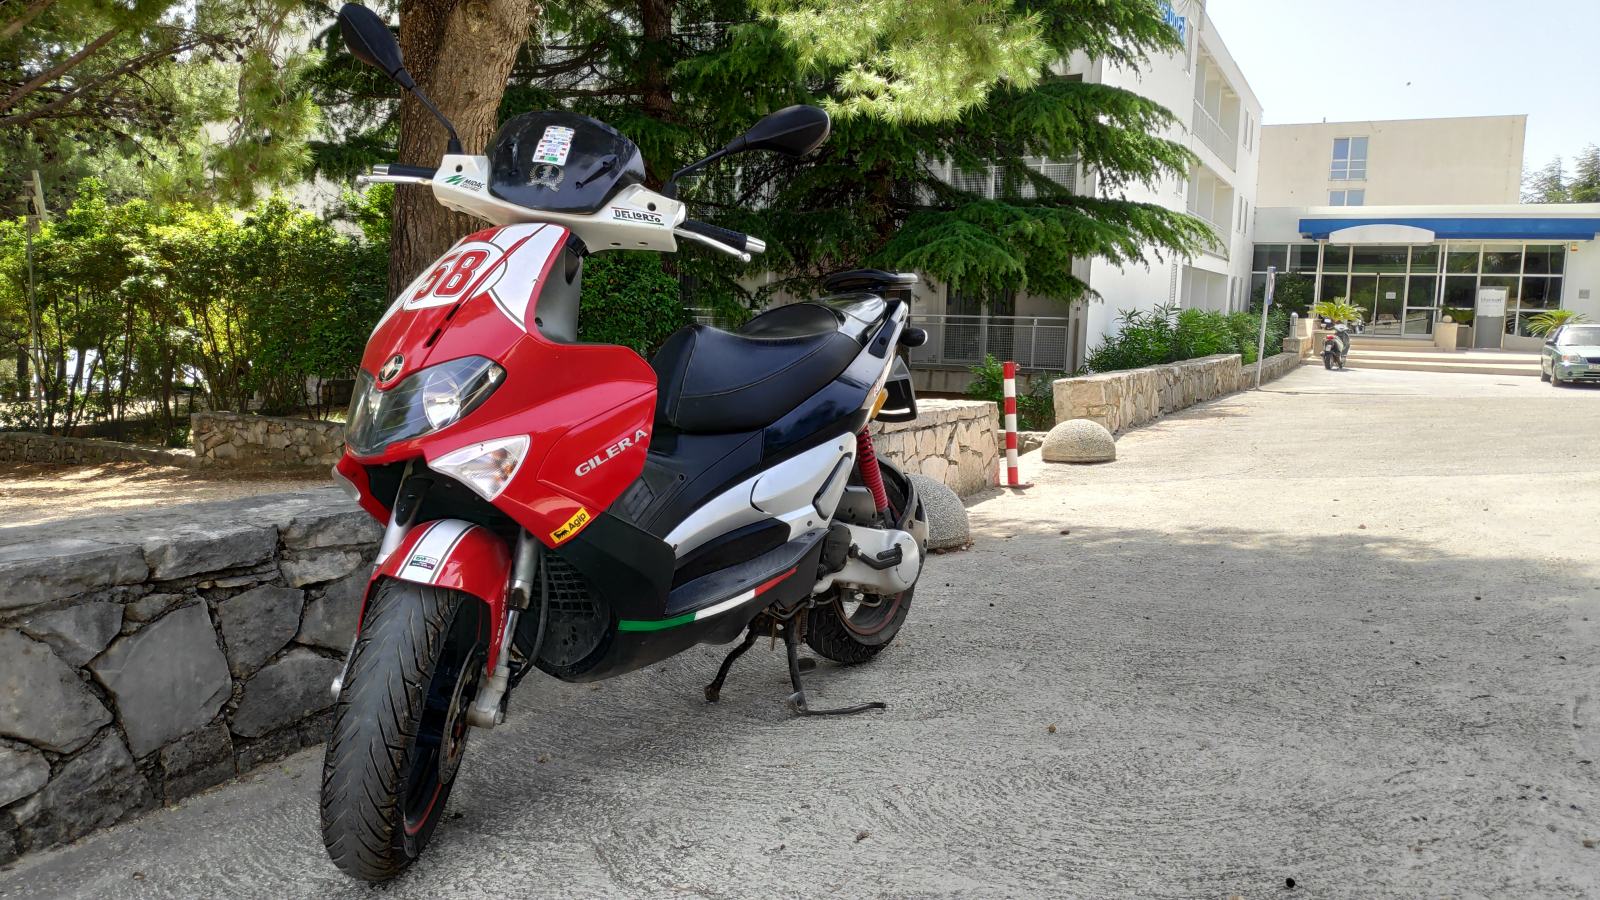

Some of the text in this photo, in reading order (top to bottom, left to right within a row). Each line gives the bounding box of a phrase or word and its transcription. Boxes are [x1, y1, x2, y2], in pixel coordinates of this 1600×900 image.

[463, 178, 486, 189] MIDAC
[410, 249, 490, 303] 58
[574, 428, 648, 477] GILERA
[568, 512, 587, 531] Agip
